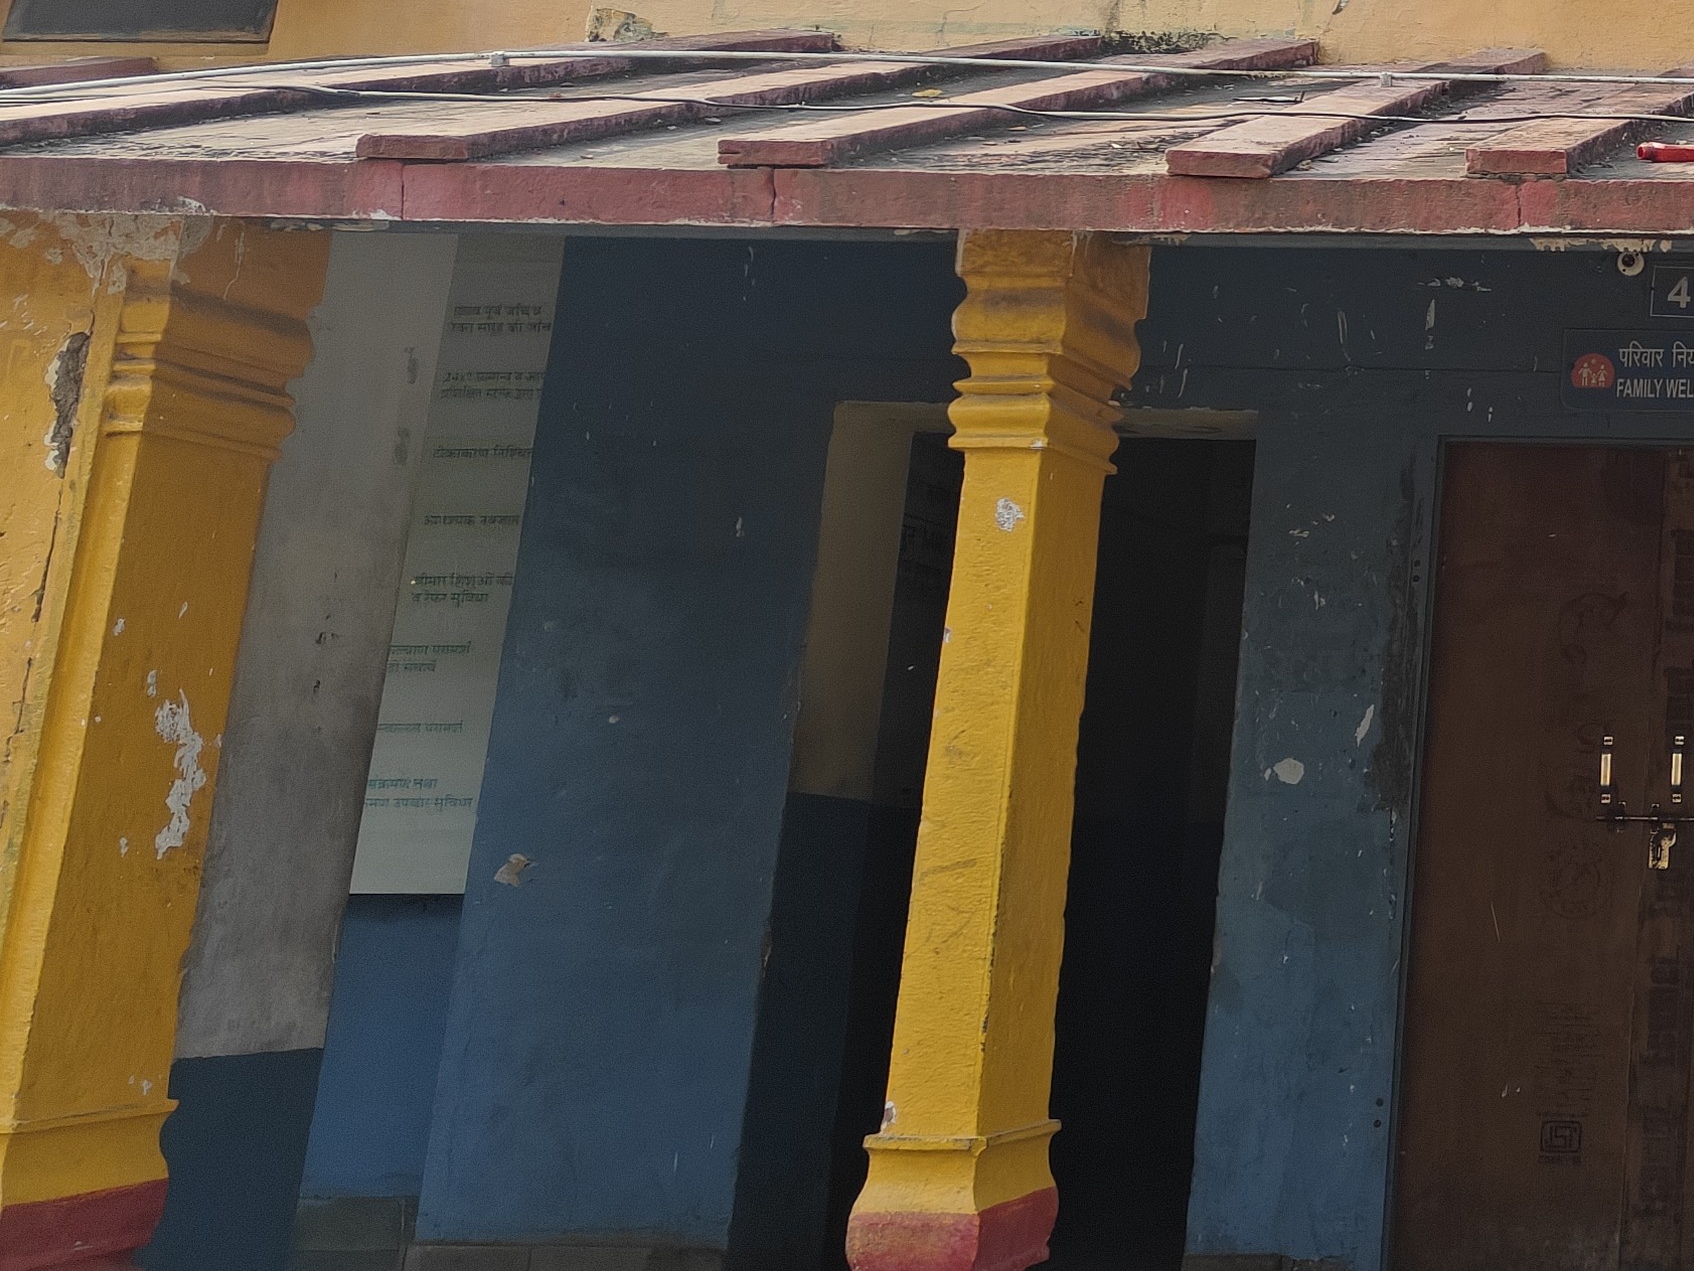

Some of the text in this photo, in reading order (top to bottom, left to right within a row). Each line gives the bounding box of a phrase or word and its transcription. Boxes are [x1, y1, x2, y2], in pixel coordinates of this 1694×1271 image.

[1667, 276, 1691, 309] 4
[1618, 341, 1664, 369] परिवार
[1616, 378, 1663, 398] FAMILY
